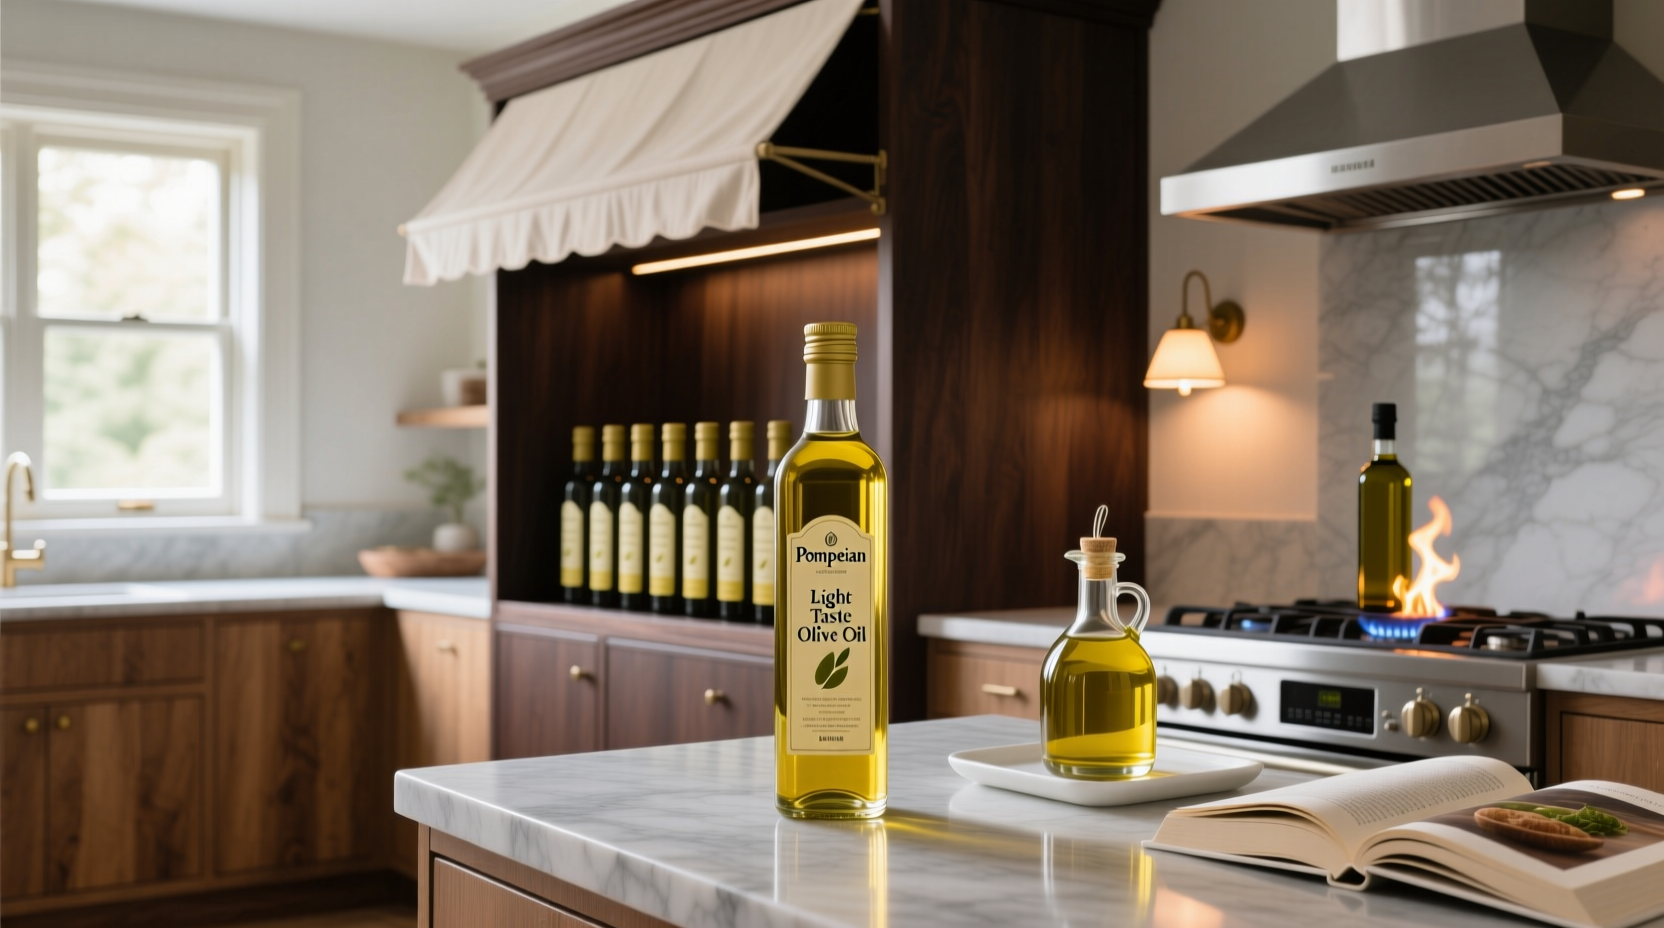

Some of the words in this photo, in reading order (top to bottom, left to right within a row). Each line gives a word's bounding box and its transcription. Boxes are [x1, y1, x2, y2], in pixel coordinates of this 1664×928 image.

[796, 546, 866, 567] Pompeian
[810, 588, 853, 609] Light
[810, 608, 852, 624] Taste
[797, 625, 838, 642] Olive
[842, 626, 866, 642] Oil
